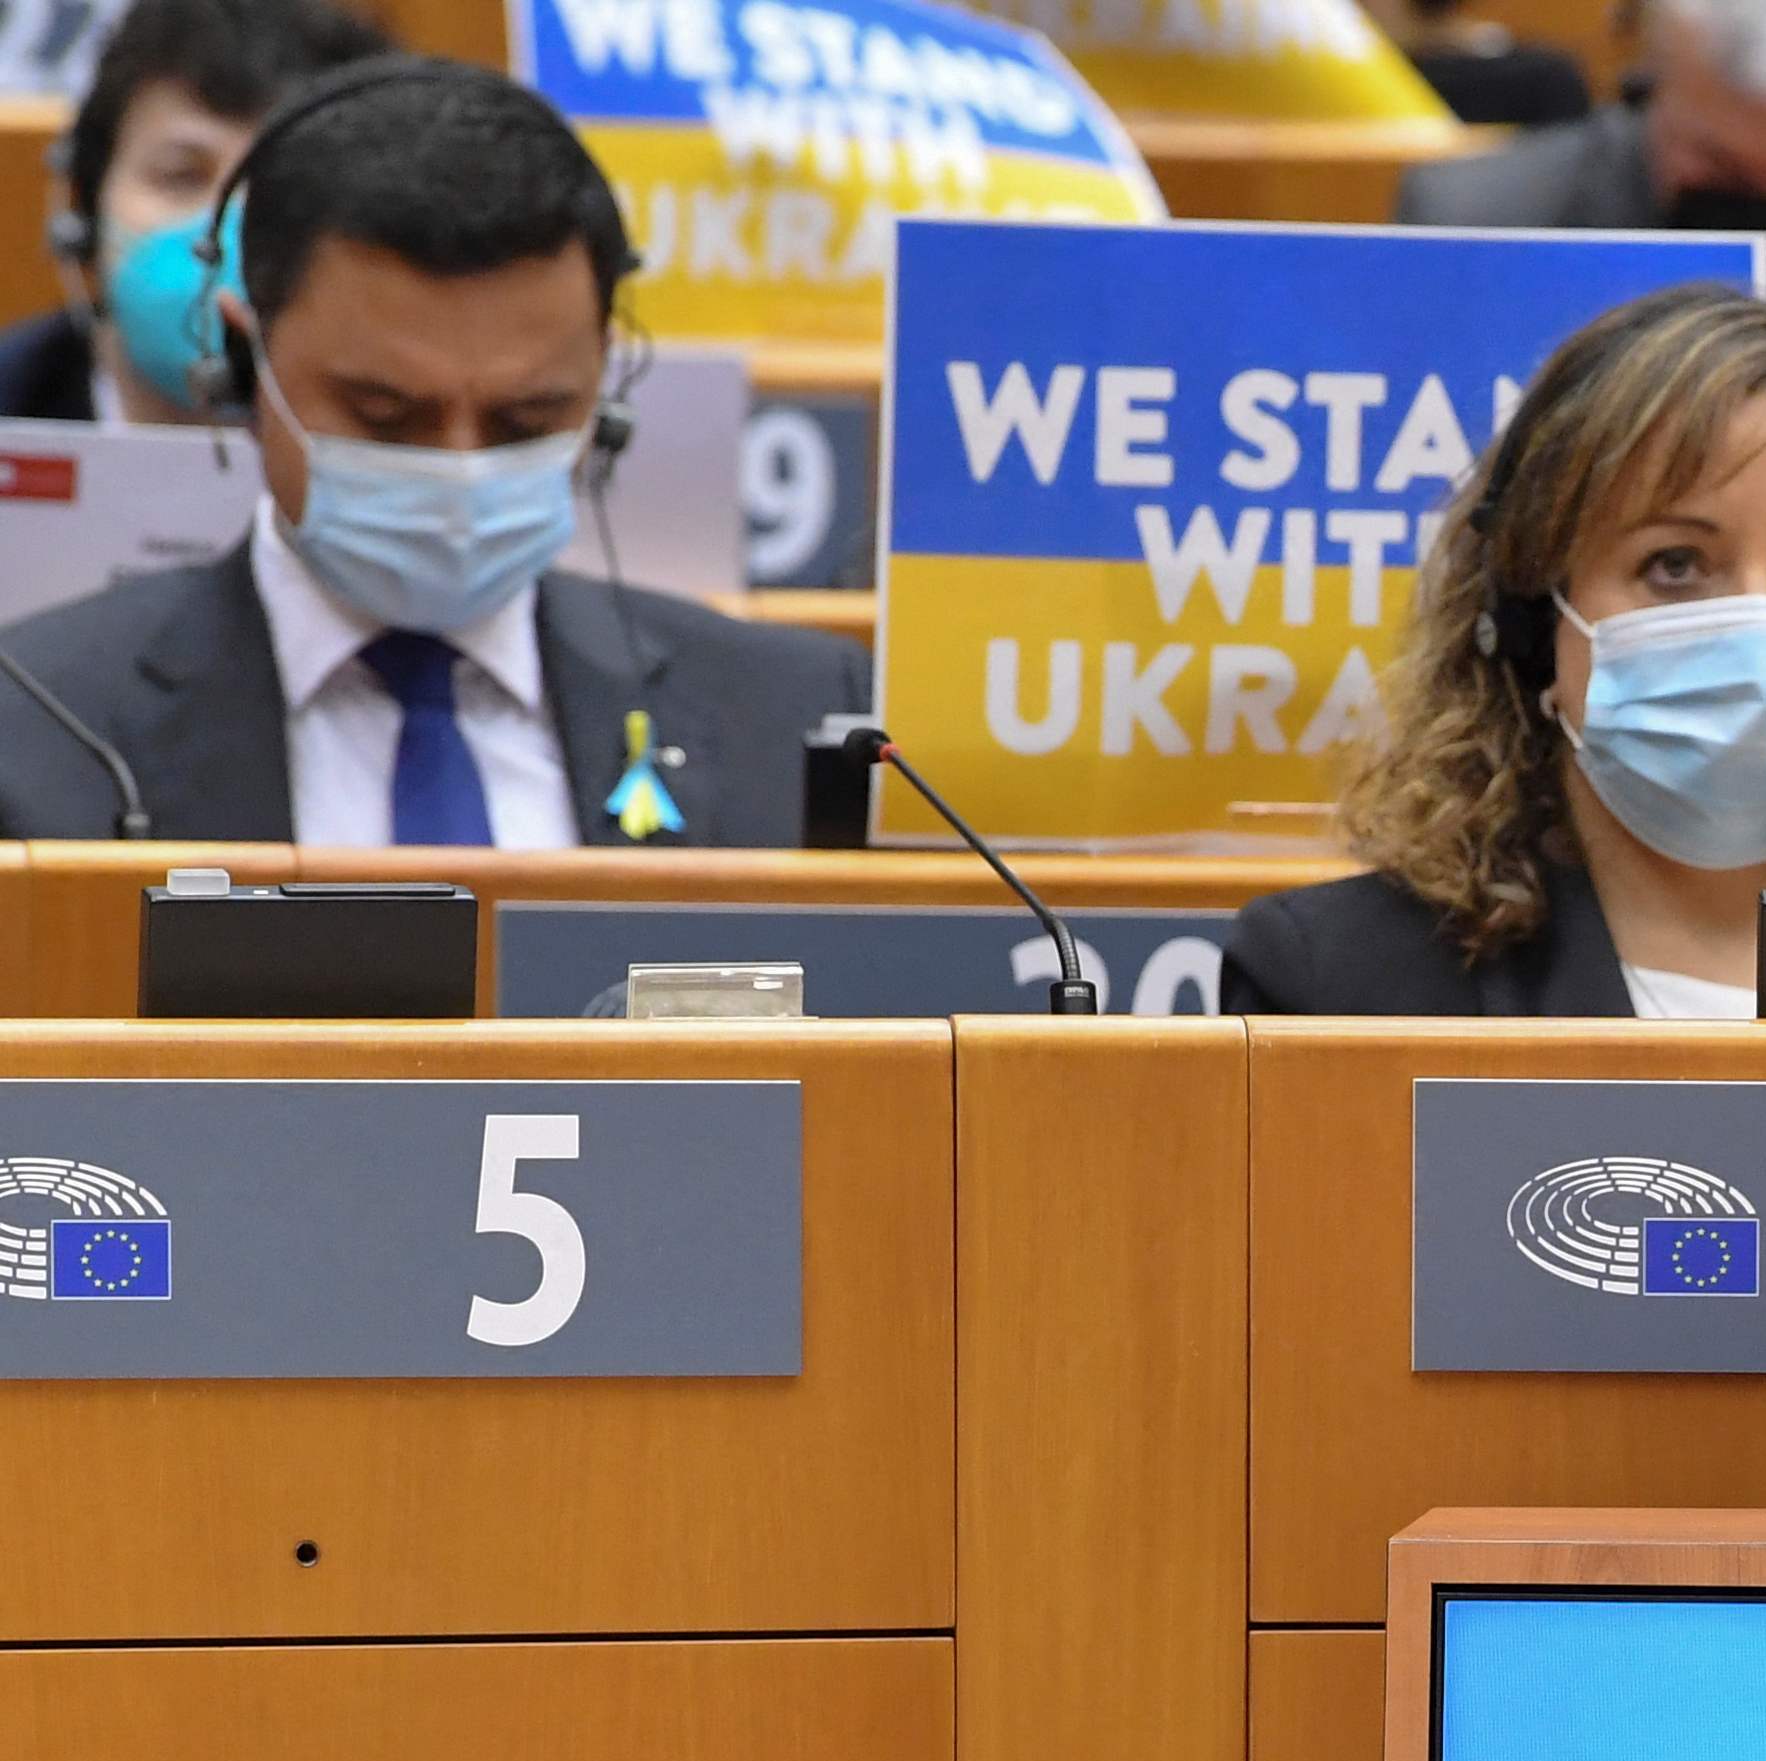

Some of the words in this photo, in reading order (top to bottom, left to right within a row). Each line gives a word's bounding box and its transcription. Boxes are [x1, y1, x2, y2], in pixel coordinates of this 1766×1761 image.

[552, 0, 738, 80] WE
[739, 0, 1080, 137] STAND
[700, 82, 988, 196] WITH
[945, 361, 1178, 486] WE
[1219, 369, 1525, 492] STA
[984, 636, 1392, 758] UKRA
[465, 1114, 587, 1347] 5
